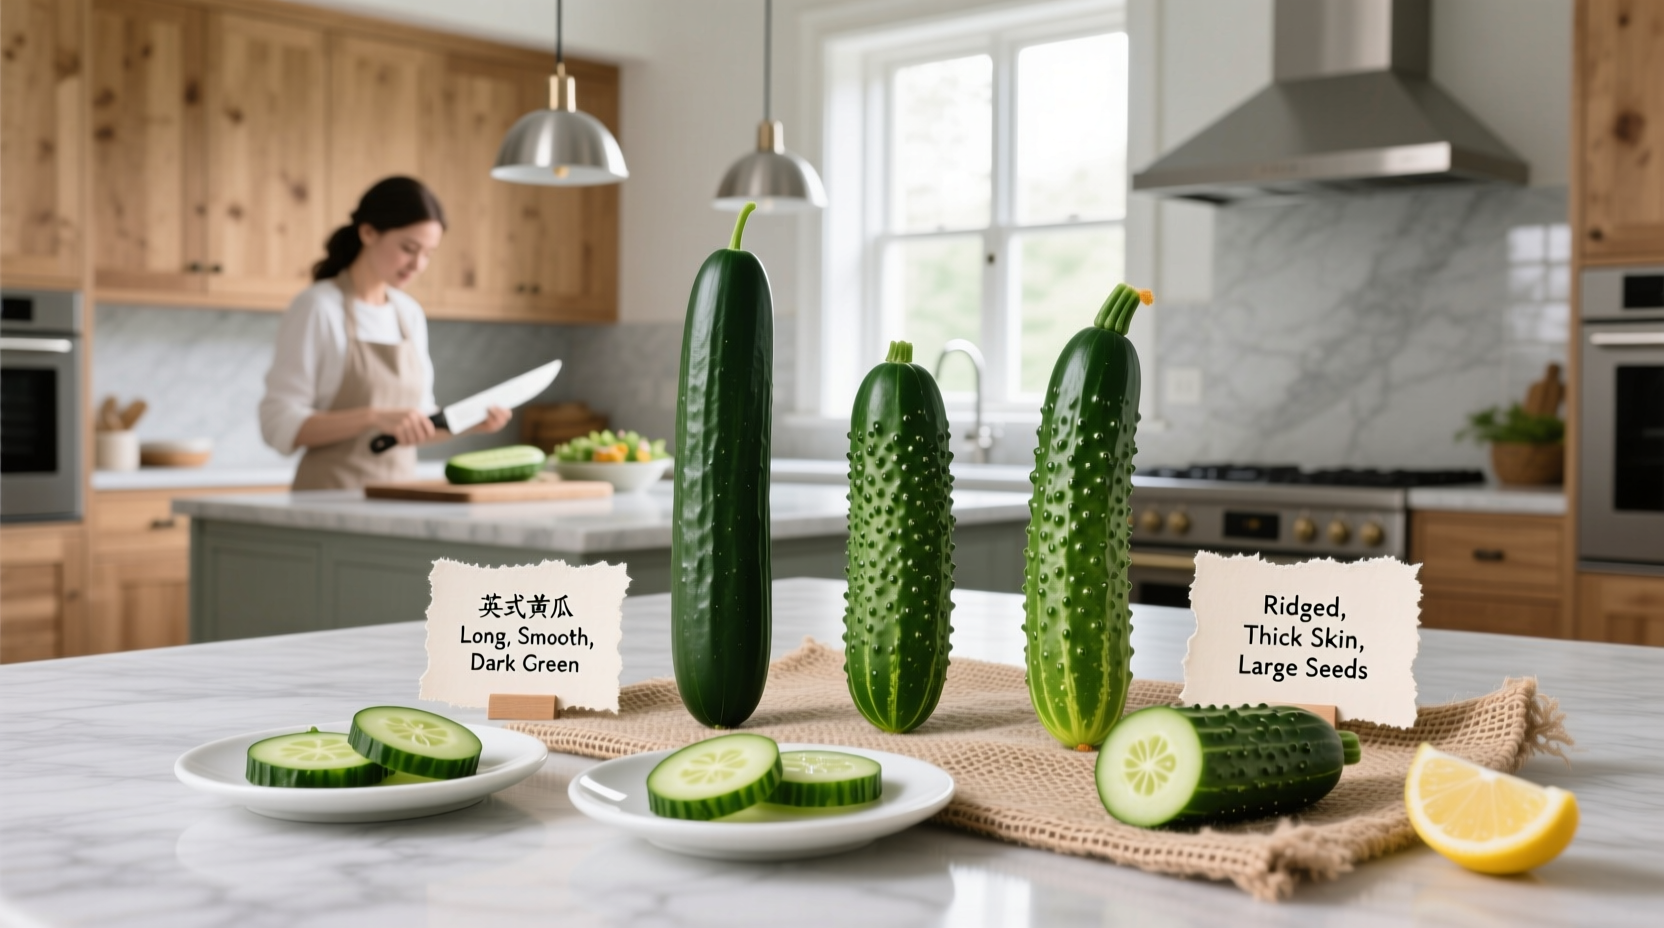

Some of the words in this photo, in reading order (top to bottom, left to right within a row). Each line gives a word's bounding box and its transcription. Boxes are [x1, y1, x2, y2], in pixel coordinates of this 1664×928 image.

[478, 592, 574, 620] 英式黄瓜
[1264, 594, 1346, 623] Ridged,
[460, 624, 511, 650] Long,
[517, 625, 594, 650] Smooth,
[1243, 624, 1303, 647] Thick
[1310, 626, 1365, 654] Skin,
[470, 652, 516, 672] Dark
[522, 653, 579, 673] Green
[1238, 653, 1298, 683] Large
[1305, 656, 1368, 680] Seeds
